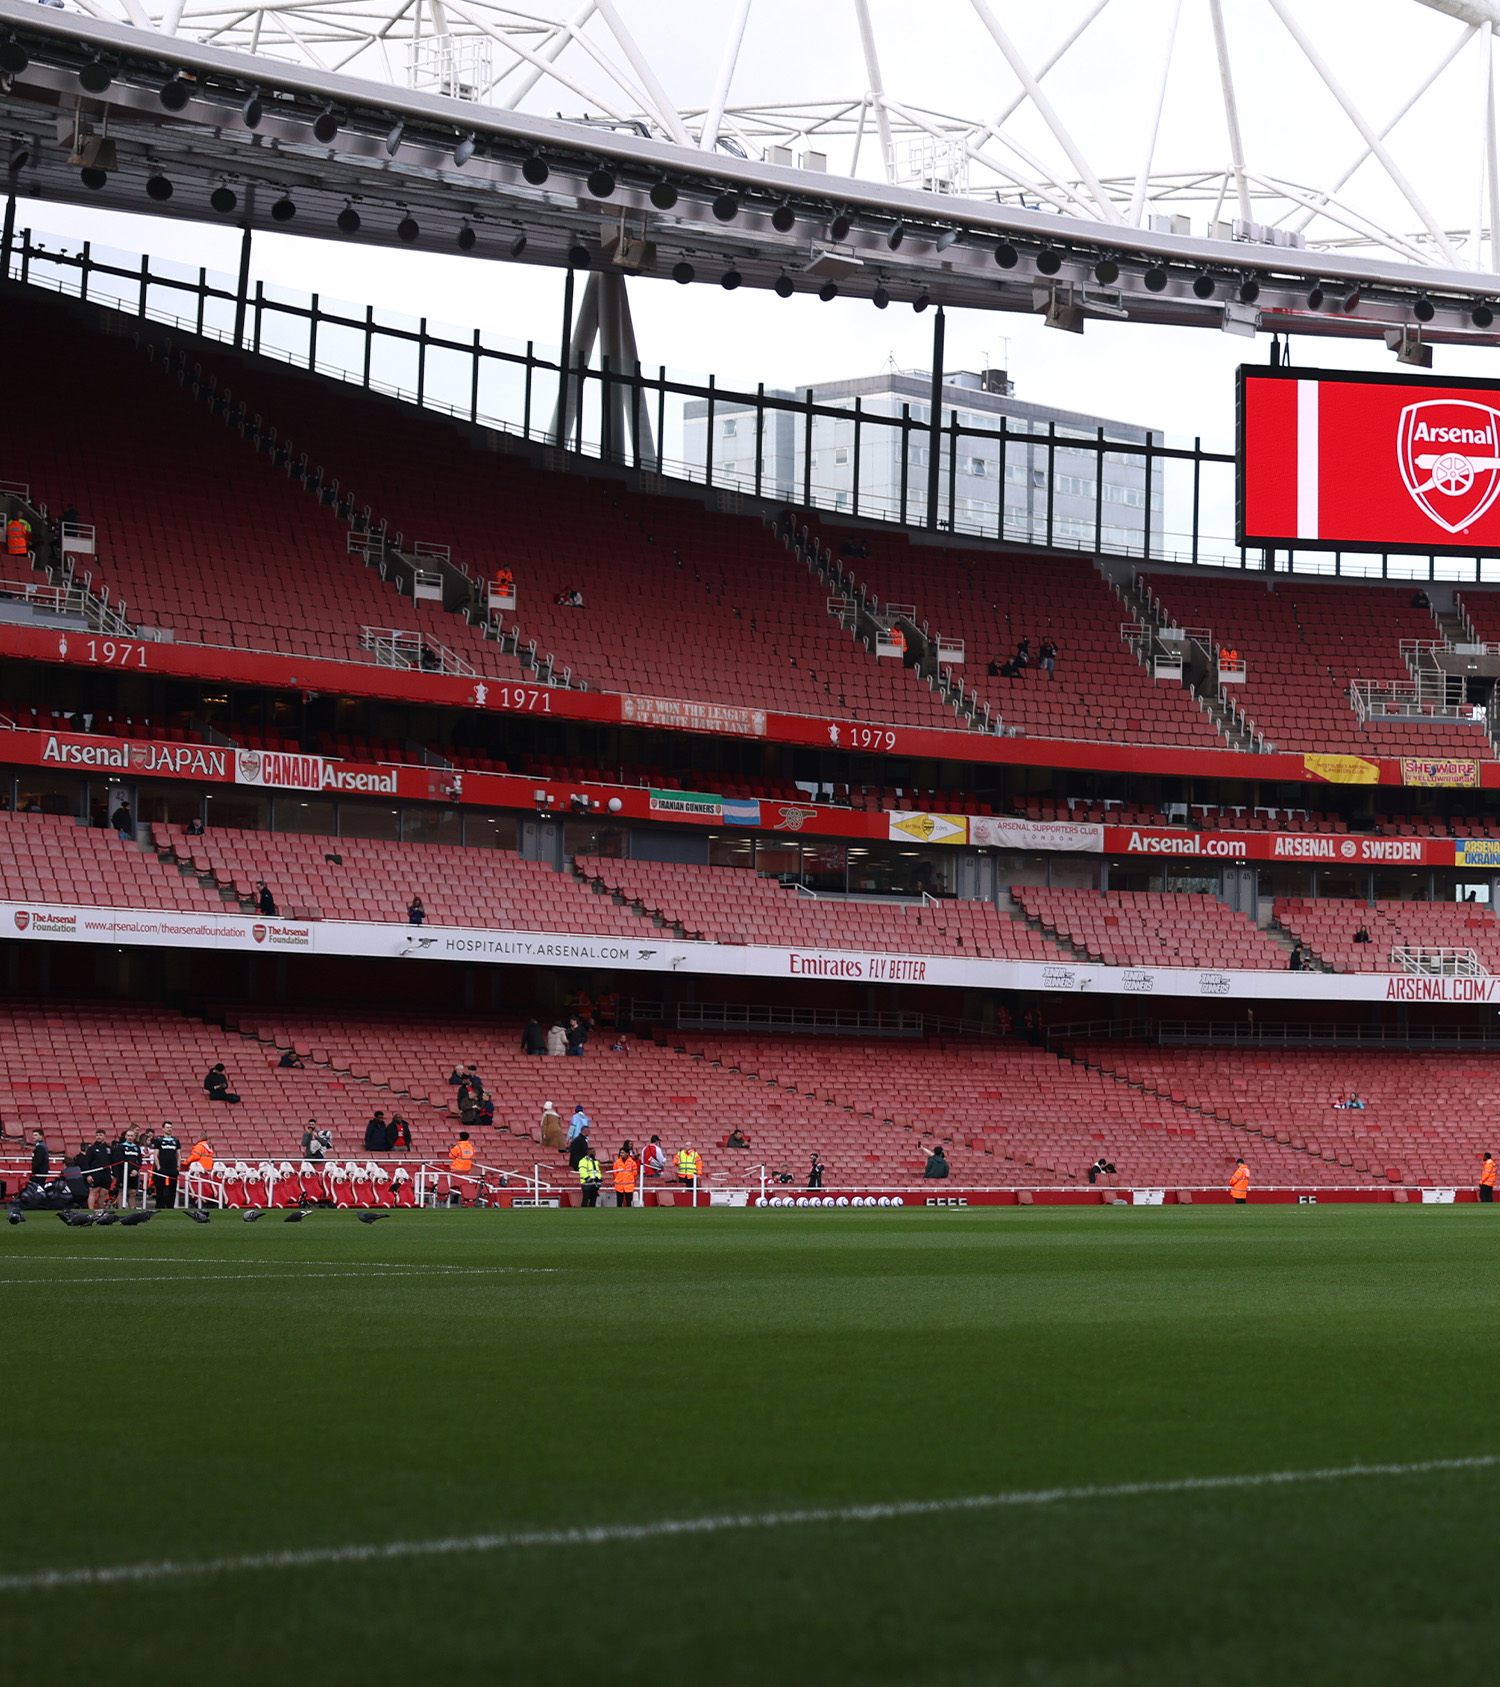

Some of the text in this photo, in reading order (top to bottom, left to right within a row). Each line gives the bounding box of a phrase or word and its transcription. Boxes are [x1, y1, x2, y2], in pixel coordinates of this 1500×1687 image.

[1413, 421, 1493, 445] Arsenal
[87, 640, 148, 668] 1971
[501, 687, 552, 713] 1971
[655, 700, 681, 715] WON
[683, 703, 706, 718] THE
[708, 706, 749, 722] LEAGUE
[851, 727, 897, 750] 1979
[42, 735, 227, 777] Arsenal JAPAN
[262, 753, 321, 789] CANADA
[1405, 762, 1475, 774] SHE WORE
[321, 763, 399, 794] Arsenal
[1414, 774, 1443, 783] YELLOW
[658, 800, 715, 814] IRANIAN GUNNERS
[997, 821, 1099, 836] ARSENAL SUPPORTERS CLUB
[1127, 831, 1246, 857] Arsenal.com
[1274, 837, 1422, 860] ARSENAL SWEDEN
[32, 913, 46, 925] The
[46, 914, 77, 926] Arsenal
[32, 922, 77, 934] Foundation
[85, 920, 246, 938] www.arsenal.com/thearsenalfoundation
[268, 925, 282, 937] The
[282, 926, 309, 938] Arsenal
[268, 935, 309, 946] Foundation
[446, 938, 629, 961] HOSPITALITY.ARSENAL.COM
[790, 954, 927, 982] Emirates FLY BETTER
[1043, 966, 1067, 977] JUNIOR
[1122, 970, 1146, 981] JUNIOR
[1044, 977, 1075, 988] GUNNERS
[1124, 980, 1154, 991] GUNNERS
[1199, 973, 1223, 984] JUNIOR
[1201, 983, 1231, 994] GUNNERS
